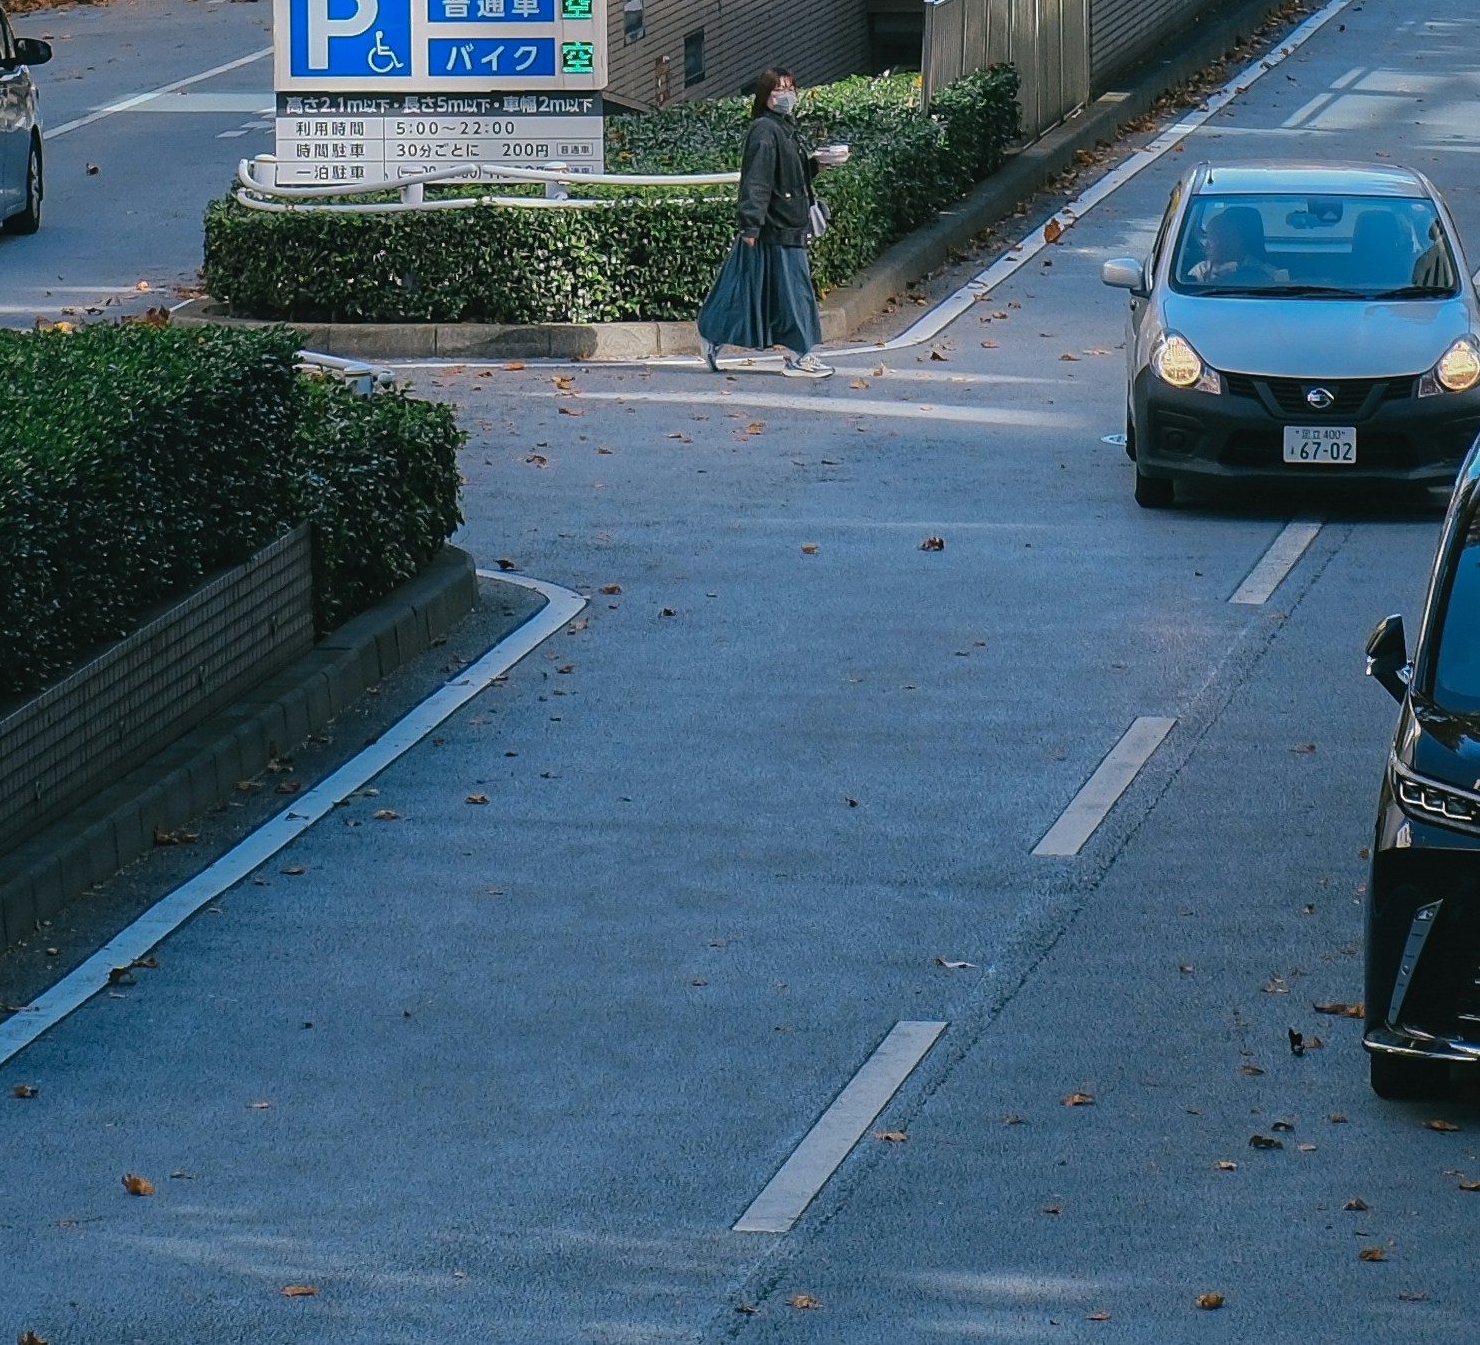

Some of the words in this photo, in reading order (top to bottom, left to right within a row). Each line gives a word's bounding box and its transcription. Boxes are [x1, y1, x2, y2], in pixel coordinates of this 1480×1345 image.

[445, 43, 539, 72] バイク
[561, 40, 595, 74] 空
[295, 120, 366, 137] 利用時間
[295, 142, 366, 159] 時間駐車
[396, 143, 480, 158] 30分ごとに
[502, 142, 549, 158] 200円
[295, 164, 366, 181] 一泊駐車
[1299, 441, 1353, 461] 67-02
